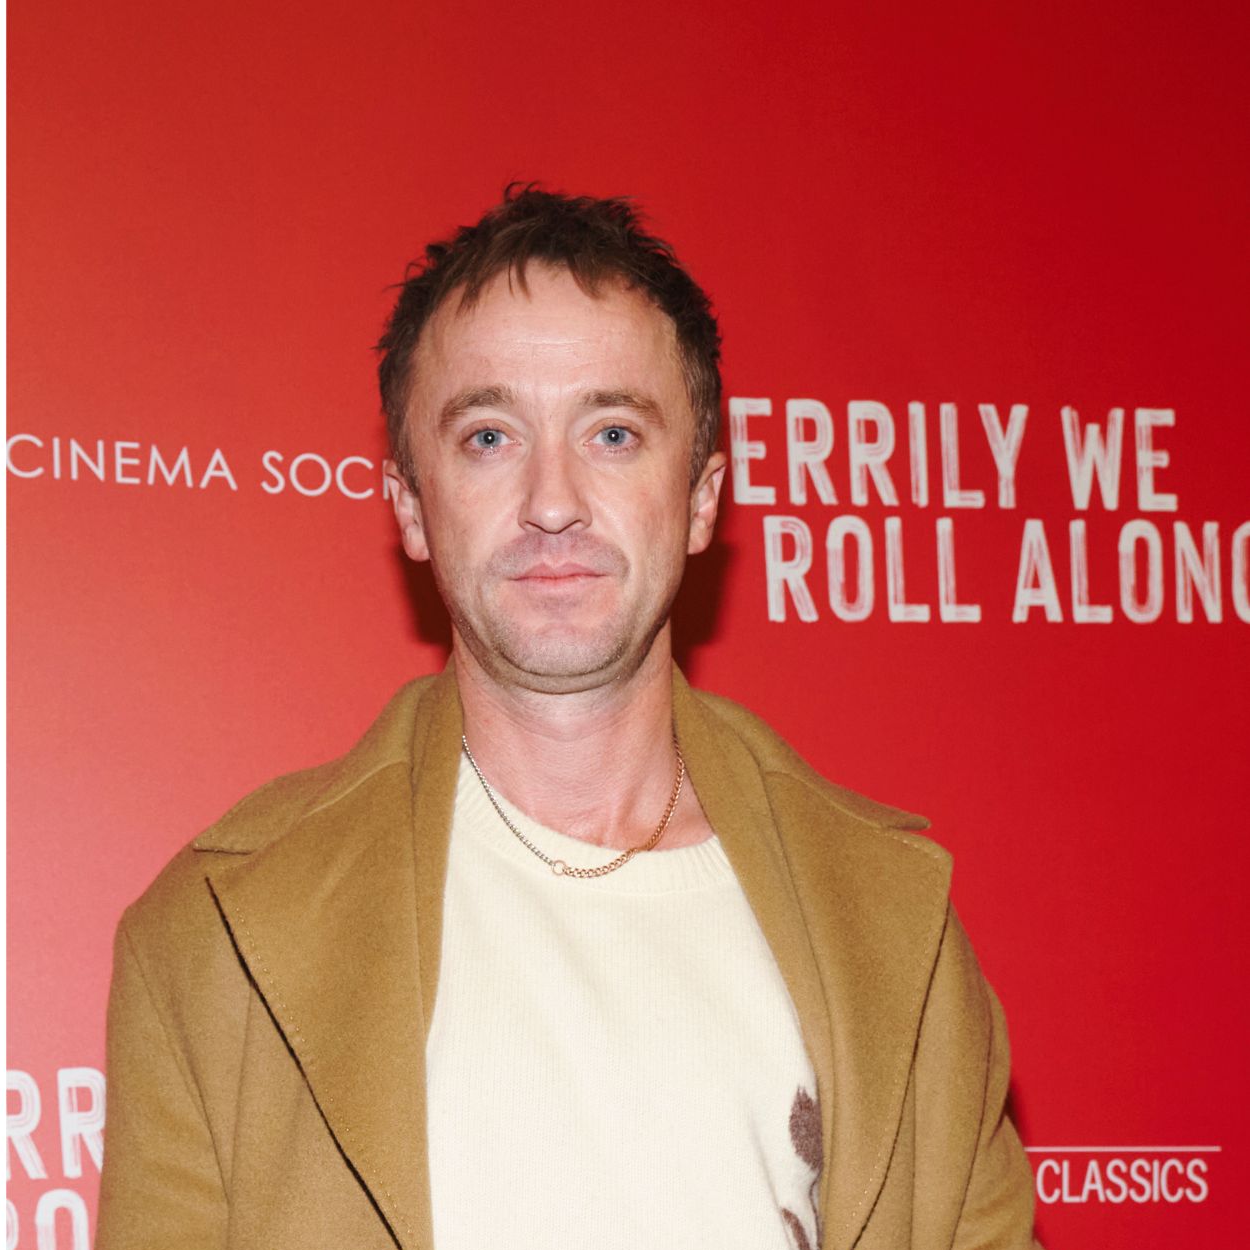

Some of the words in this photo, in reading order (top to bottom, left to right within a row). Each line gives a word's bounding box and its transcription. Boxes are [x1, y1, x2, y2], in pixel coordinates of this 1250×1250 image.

[6, 434, 238, 491] CINEMA
[729, 396, 1028, 509] ERRILY
[1061, 405, 1178, 512] WE
[763, 515, 982, 623] ROLL
[1036, 1158, 1209, 1204] CLASSICS
